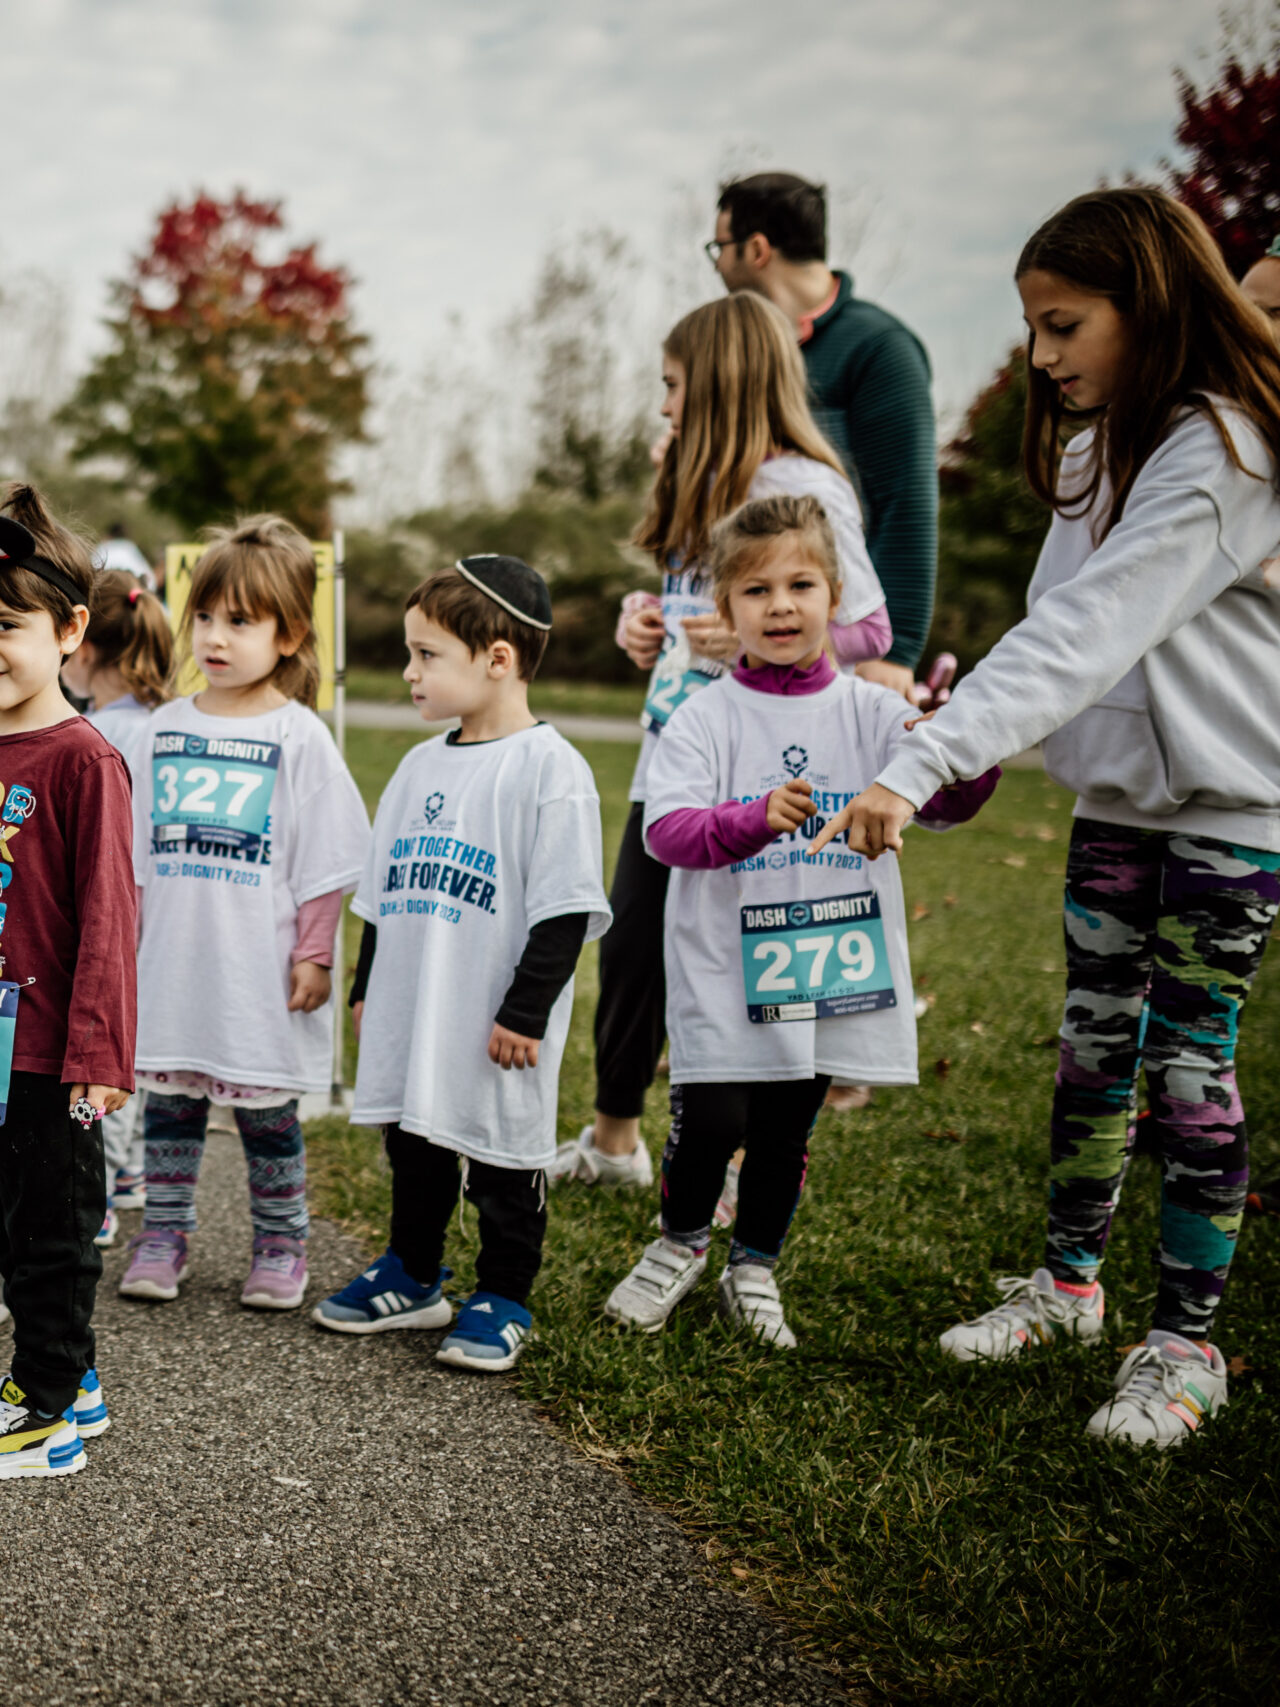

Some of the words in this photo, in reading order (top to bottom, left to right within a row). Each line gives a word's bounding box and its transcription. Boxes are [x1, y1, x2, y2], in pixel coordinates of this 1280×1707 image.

[207, 739, 272, 762] DIGNITY
[157, 765, 263, 816] 327
[418, 836, 497, 878] TOGETHER.
[835, 854, 863, 871] 2023
[182, 863, 233, 883] DIGNITY
[233, 871, 261, 887] 2023
[409, 862, 497, 915] FOREVER.
[407, 899, 440, 916] DIGNY
[746, 907, 787, 928] DASH
[812, 896, 873, 922] DIGNITY
[753, 930, 876, 992] 279
